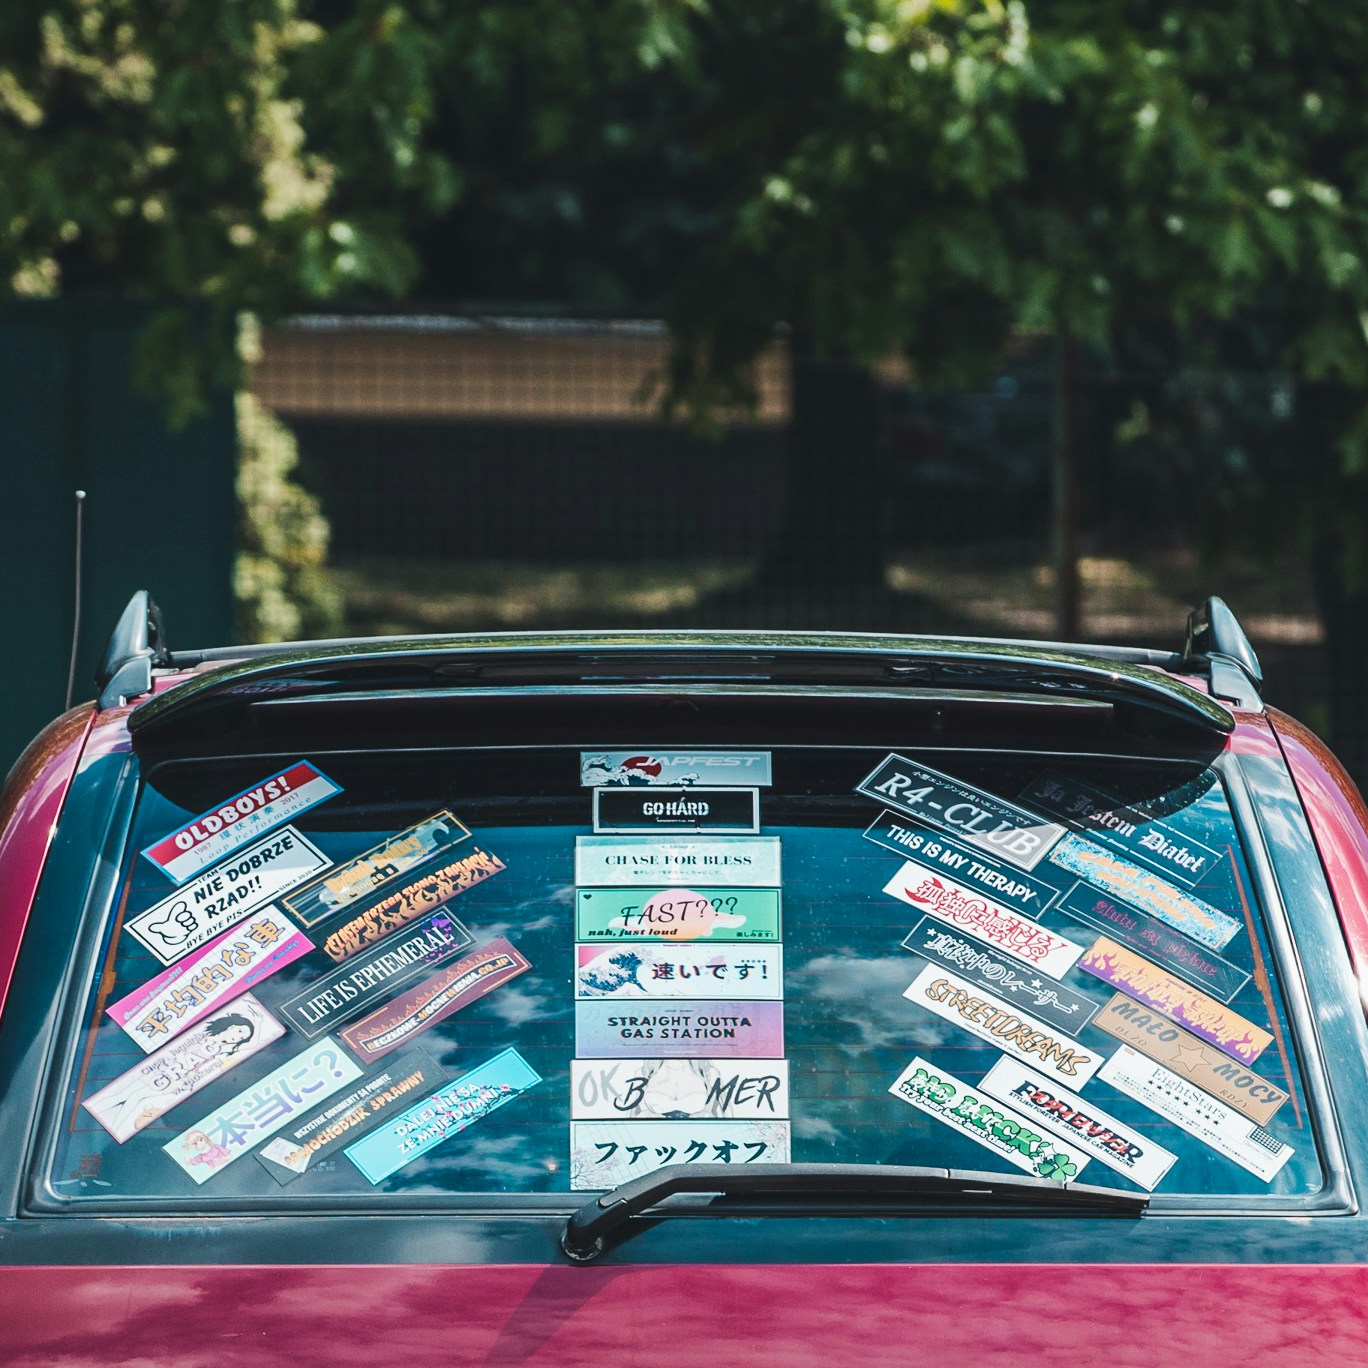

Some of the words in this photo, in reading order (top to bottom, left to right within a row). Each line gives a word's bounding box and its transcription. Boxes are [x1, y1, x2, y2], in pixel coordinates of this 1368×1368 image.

[636, 756, 761, 767] JAPFEST
[174, 775, 291, 850] OLDBOYS!
[280, 793, 300, 806] 2017
[643, 802, 664, 816] GO
[666, 802, 710, 816] HARD
[193, 842, 212, 856] 1987
[199, 842, 230, 864] Loop
[234, 797, 312, 843] Performance
[193, 877, 224, 904] NIE
[226, 835, 294, 882] DOBRZE
[197, 868, 219, 884] TEAM
[605, 856, 659, 865] CHASE
[664, 856, 697, 865] FOR
[704, 856, 752, 865] BLESS
[886, 824, 925, 849] THIS
[922, 841, 942, 858] IS
[938, 849, 970, 870] MY
[967, 861, 1037, 903] THERAPY
[204, 875, 263, 919] RZAD!!
[278, 878, 297, 891] SINCE
[186, 933, 204, 949] BYE
[206, 921, 224, 937] BYE
[227, 909, 243, 925] PIS
[621, 896, 738, 926] FAST???
[588, 929, 617, 937] nah,
[618, 929, 646, 937] just
[648, 928, 678, 936] loud
[135, 917, 286, 1038] 平均的な車
[297, 989, 343, 1024] LIFE
[339, 979, 358, 1002] IS
[349, 925, 455, 992] EPHEMERAL
[652, 963, 768, 980] 速いです!
[607, 1016, 691, 1027] STRAIGHT
[697, 1016, 752, 1027] OUTTA
[620, 1028, 654, 1039] GAS
[660, 1028, 736, 1039] STATION
[925, 979, 1091, 1076] STREETDREAMS
[207, 1049, 343, 1150] 本当に?
[371, 1070, 425, 1112] SPRAWNY
[578, 1063, 623, 1107] OK
[1212, 1062, 1282, 1104] MOCY
[395, 1105, 435, 1138] DALEJ
[434, 1089, 463, 1117] NIE
[397, 1137, 415, 1155] ZE
[416, 1114, 453, 1146] MNIE
[899, 1083, 917, 1101] Try
[916, 1092, 944, 1113] your
[942, 1107, 965, 1126] best
[964, 1121, 988, 1139] next
[986, 1132, 1014, 1154] time!
[1009, 1092, 1033, 1110] STYLISH
[1033, 1105, 1061, 1123] FOREVER
[1062, 1123, 1092, 1143] JAPANESE
[1091, 1139, 1106, 1151] CAR
[1104, 1147, 1135, 1169] MAGAZINE
[1012, 1080, 1144, 1164] FOREVER
[594, 1139, 768, 1165] ファックオフ
